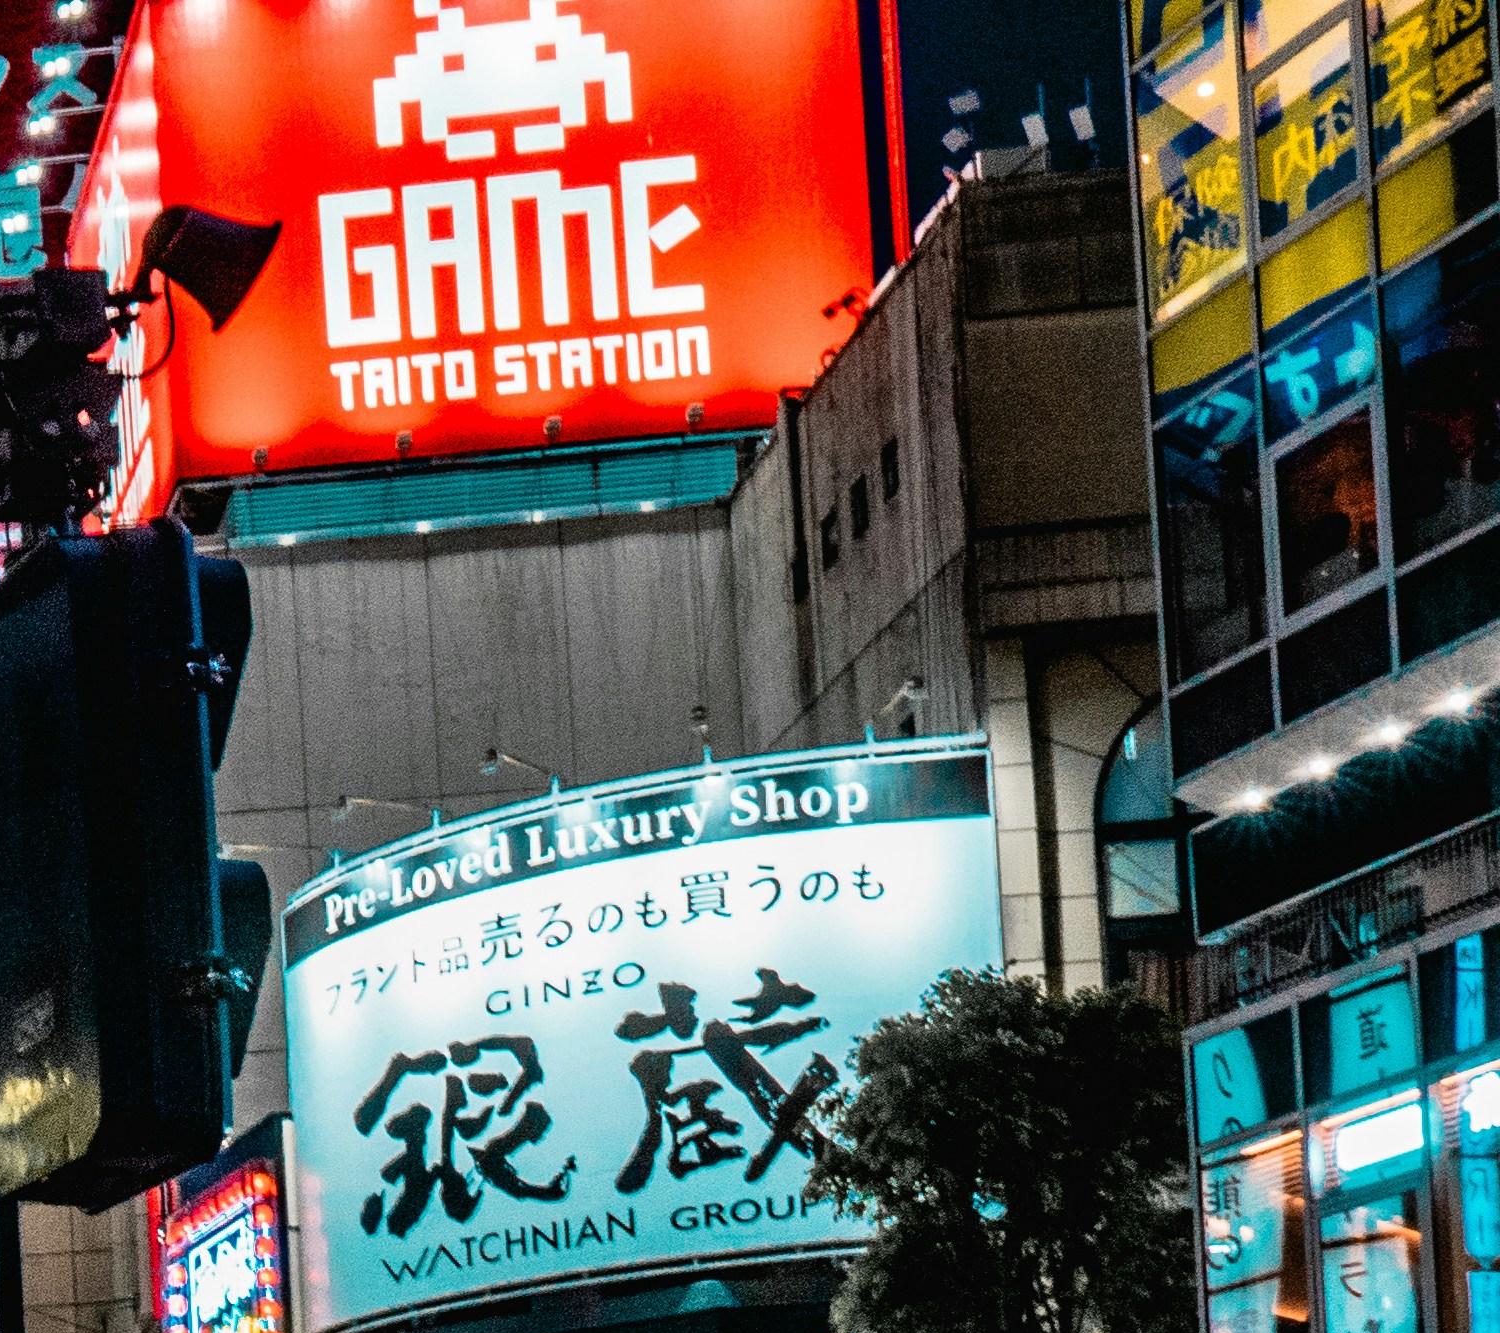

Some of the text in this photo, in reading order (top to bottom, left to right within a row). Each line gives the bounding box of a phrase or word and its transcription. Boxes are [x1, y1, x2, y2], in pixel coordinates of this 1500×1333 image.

[318, 155, 705, 348] GAME
[330, 325, 711, 412] TAITO STATION
[324, 776, 869, 936] Pre-Loved Luxury Shop
[484, 962, 647, 1018] GINZO
[381, 1206, 637, 1285] WATCHNIAN
